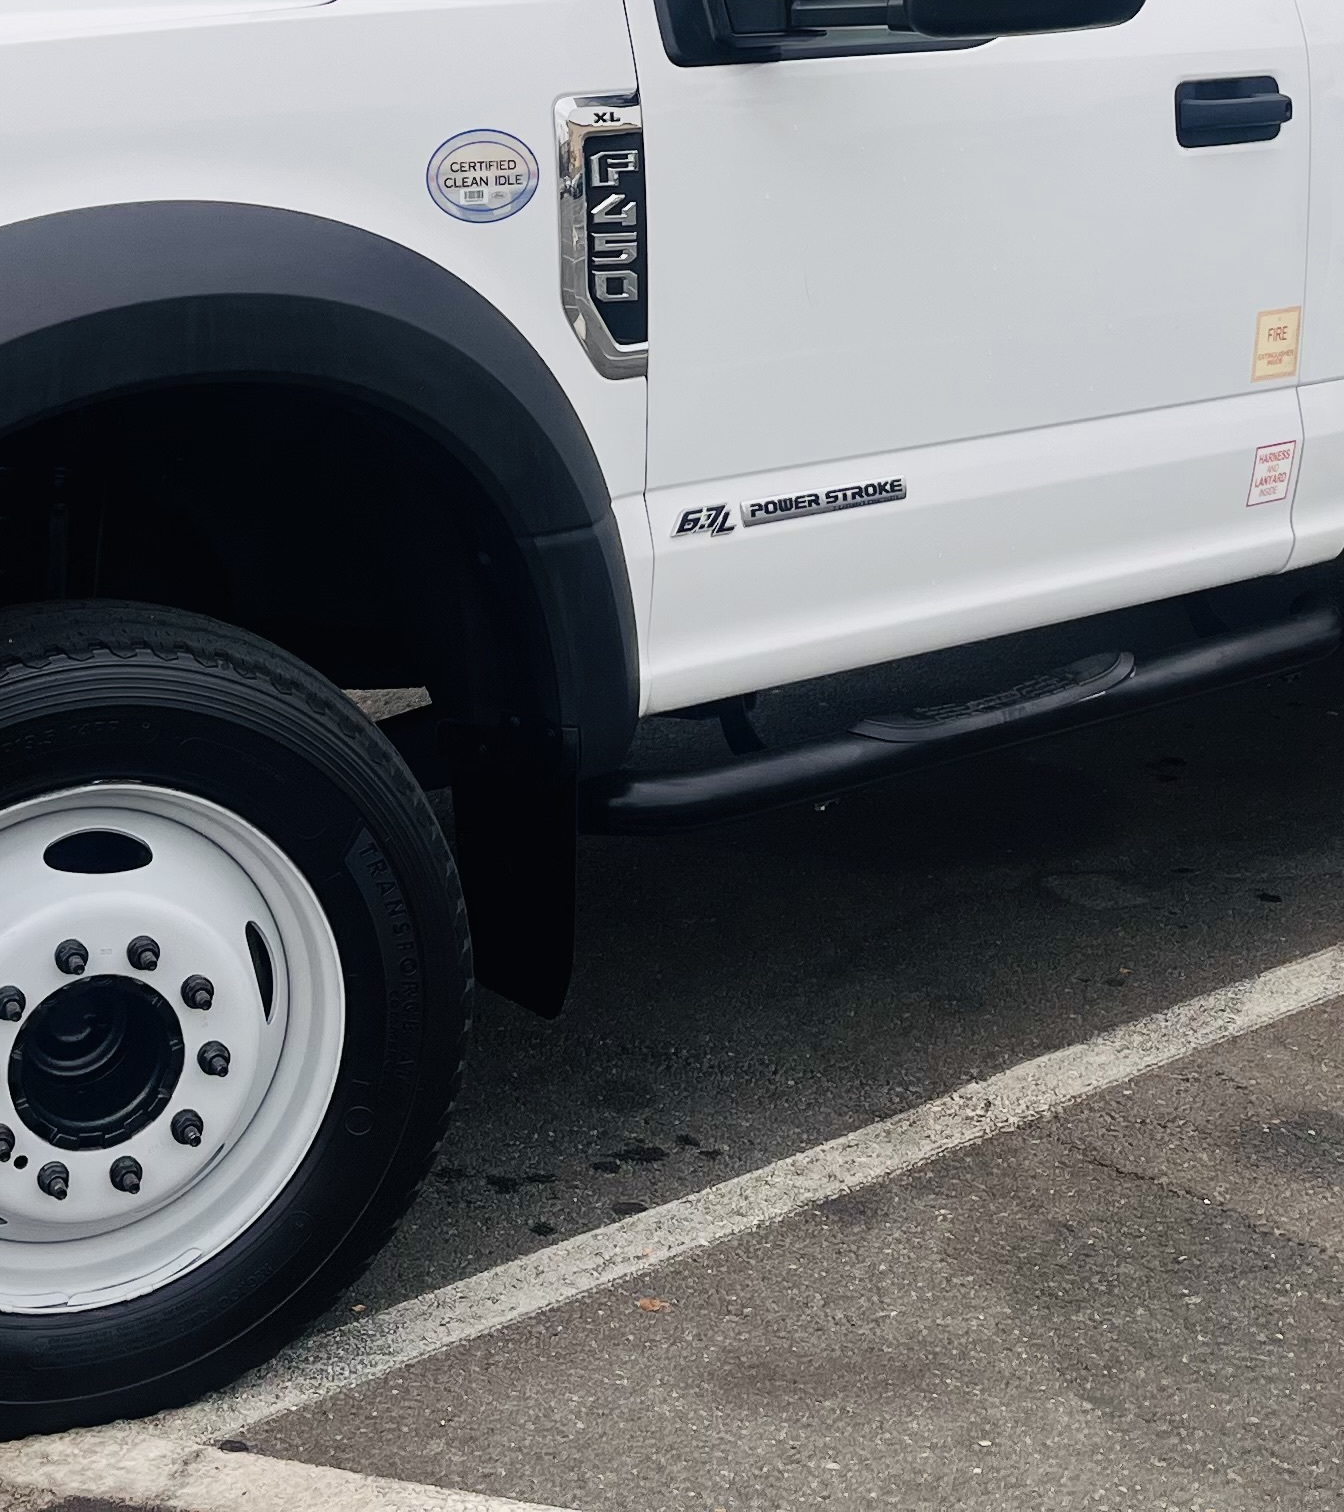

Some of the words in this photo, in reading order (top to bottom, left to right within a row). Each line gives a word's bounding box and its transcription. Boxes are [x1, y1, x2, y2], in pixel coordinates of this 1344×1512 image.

[593, 111, 621, 123] XL
[450, 159, 517, 173] CERTIFIED
[443, 175, 489, 189] CLEAN
[494, 174, 524, 186] IDLE
[1267, 325, 1288, 342] FIRE
[1259, 448, 1290, 464] HARNESS
[1255, 472, 1287, 488] LANYARD
[671, 503, 737, 538] 6.7L
[750, 493, 821, 518] POWER
[824, 478, 903, 505] STROKE
[358, 841, 421, 1034] TRANSFORCE
